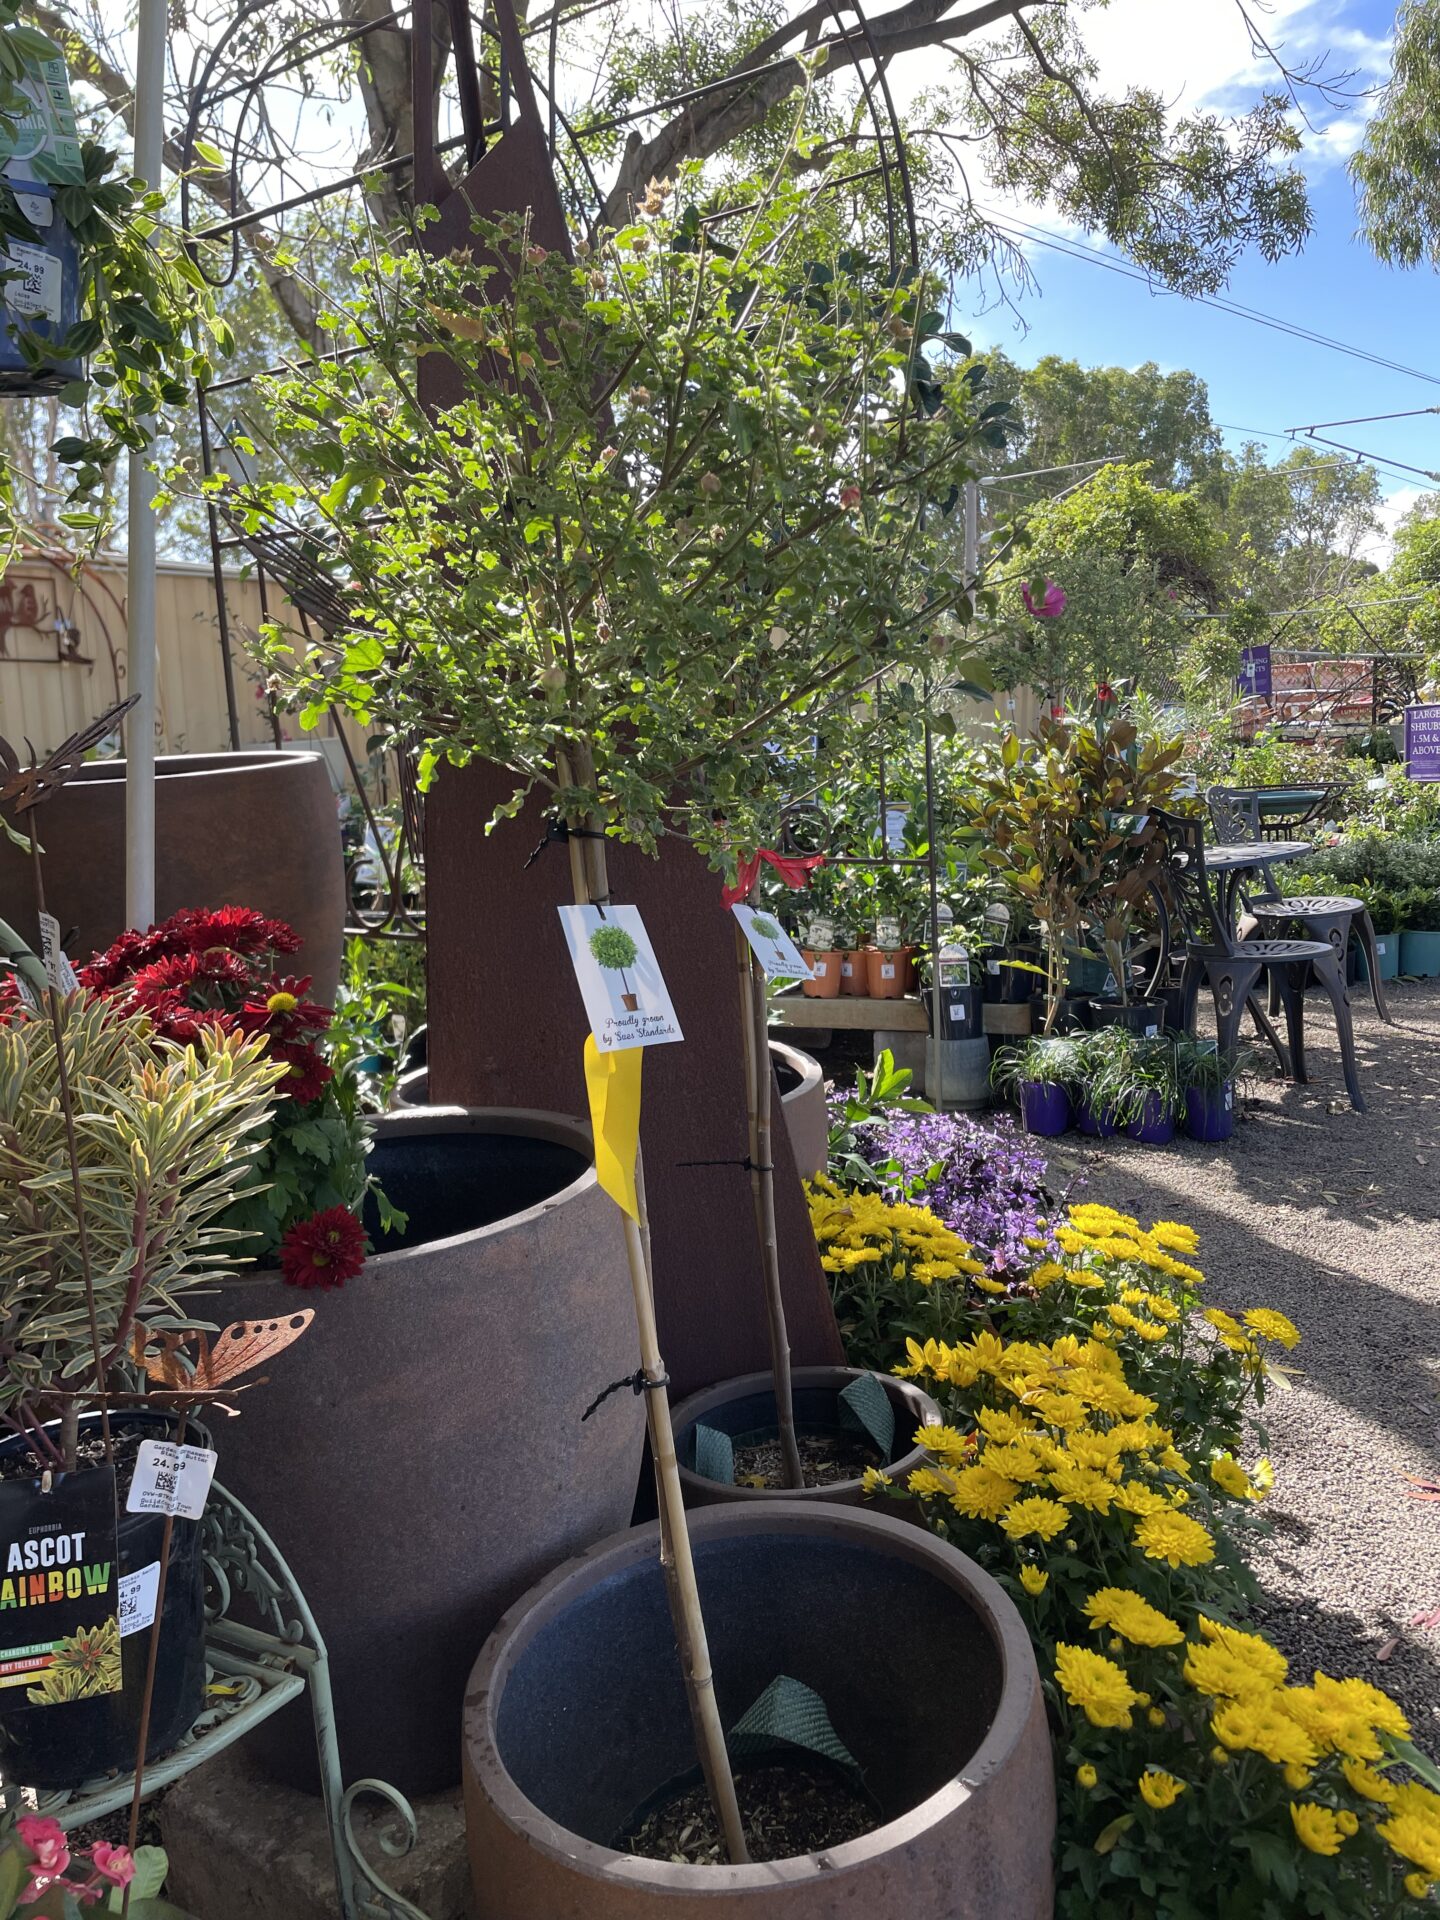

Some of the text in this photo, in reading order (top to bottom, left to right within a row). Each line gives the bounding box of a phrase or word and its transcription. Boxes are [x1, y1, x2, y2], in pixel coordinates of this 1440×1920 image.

[1413, 709, 1440, 719] LARGE
[1413, 734, 1439, 743] 1.5M &
[1412, 746, 1440, 755] ABOVE
[605, 1015, 664, 1028] Proudly grown
[602, 1033, 612, 1046] by
[636, 1024, 675, 1038] Standards
[7, 1532, 86, 1573] ASCOT
[0, 1562, 111, 1610] AINBOW
[15, 1659, 43, 1670] TOLERANT
